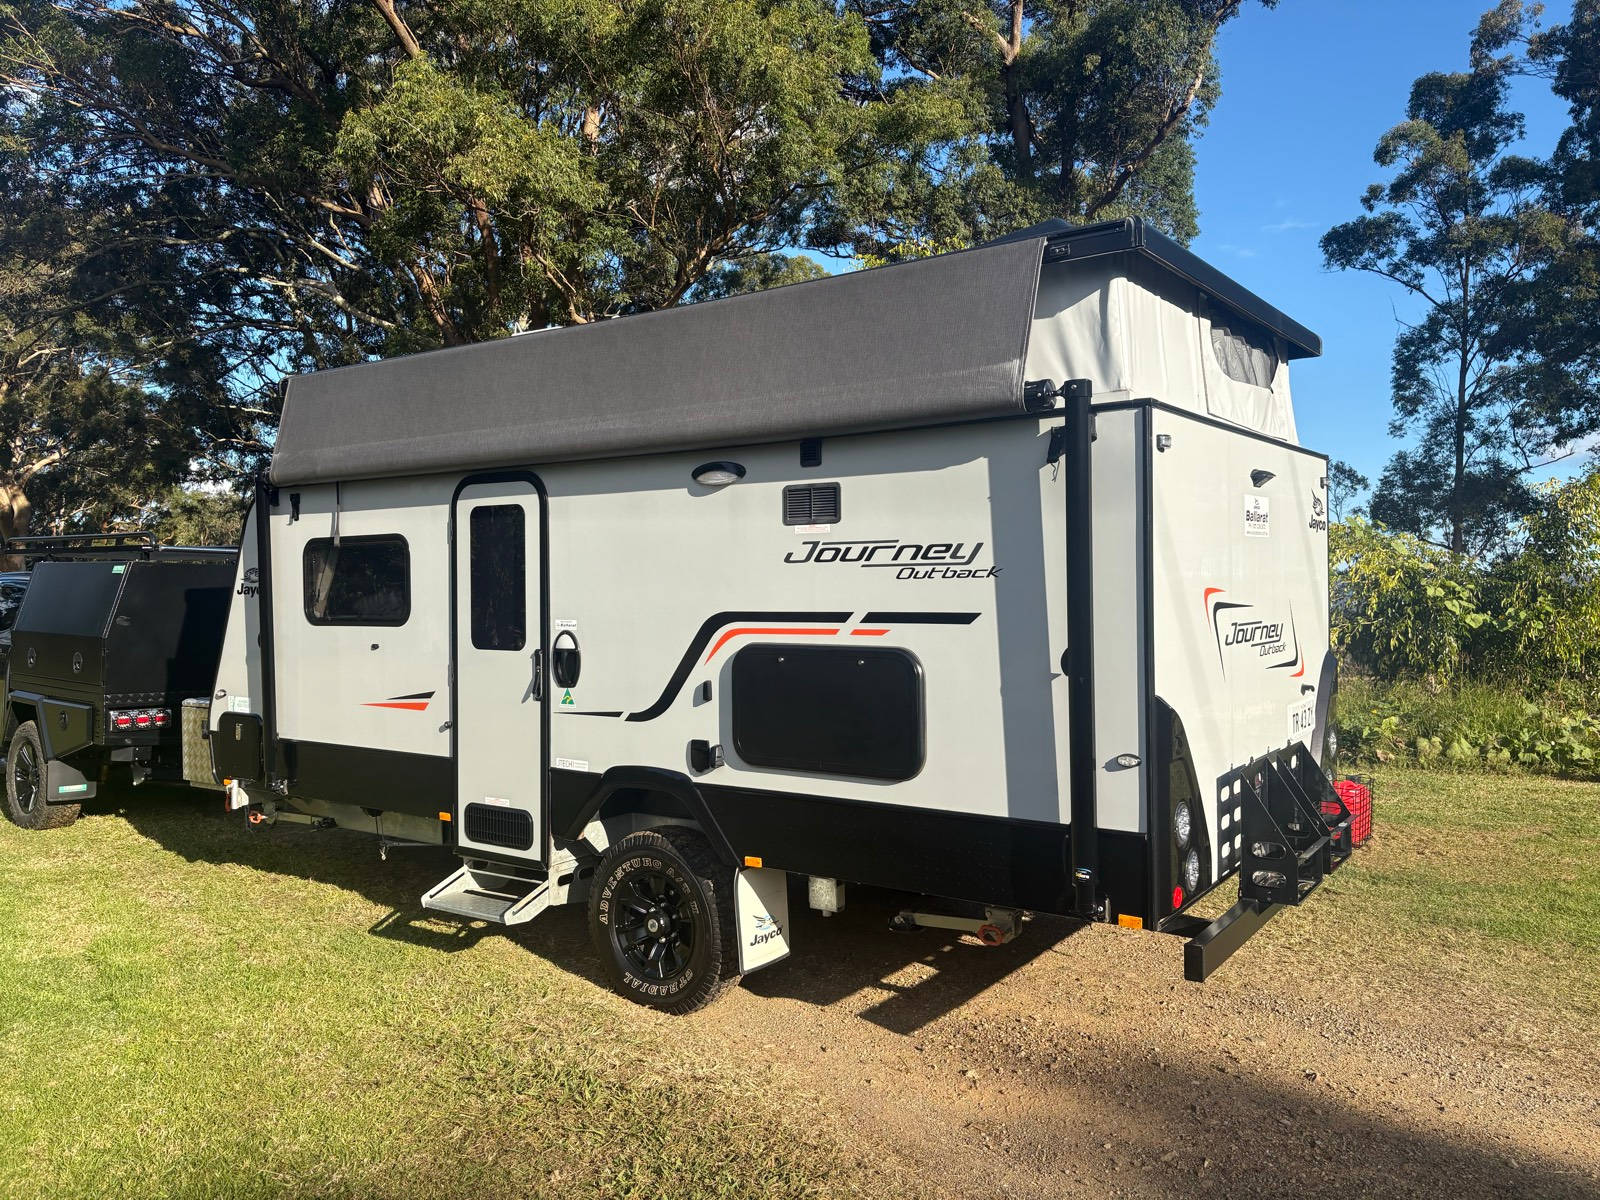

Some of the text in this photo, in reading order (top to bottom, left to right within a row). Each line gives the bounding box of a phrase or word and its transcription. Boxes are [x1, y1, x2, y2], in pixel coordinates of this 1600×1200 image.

[1245, 510, 1269, 523] Ballarat
[1308, 514, 1326, 533] Jayco
[783, 539, 984, 567] Journey
[895, 566, 1004, 580] Outback
[1224, 620, 1284, 648] Journey
[1259, 643, 1287, 657] Outback
[599, 857, 662, 925] ADVENTURO
[750, 927, 782, 947] Jayco
[623, 971, 680, 996] RADIAL
